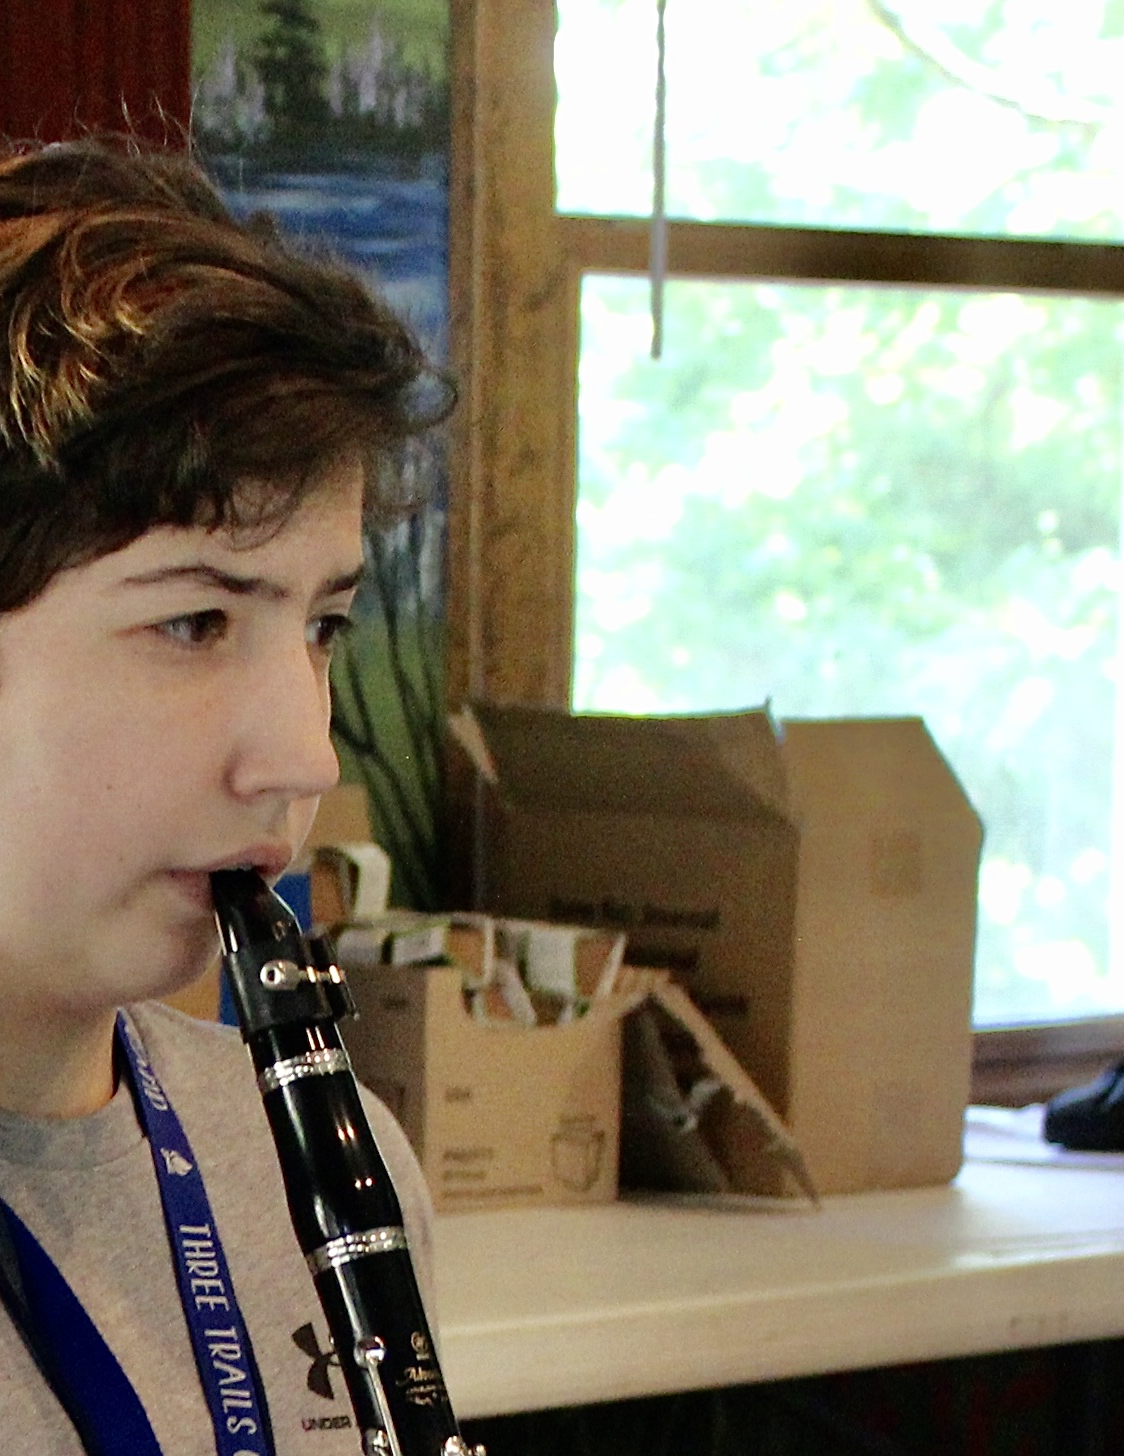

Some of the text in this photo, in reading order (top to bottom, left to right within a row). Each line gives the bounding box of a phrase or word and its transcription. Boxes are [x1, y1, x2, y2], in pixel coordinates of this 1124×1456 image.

[178, 1221, 229, 1313] THREE
[203, 1326, 257, 1435] TRAILS
[302, 1415, 352, 1432] UNDER
